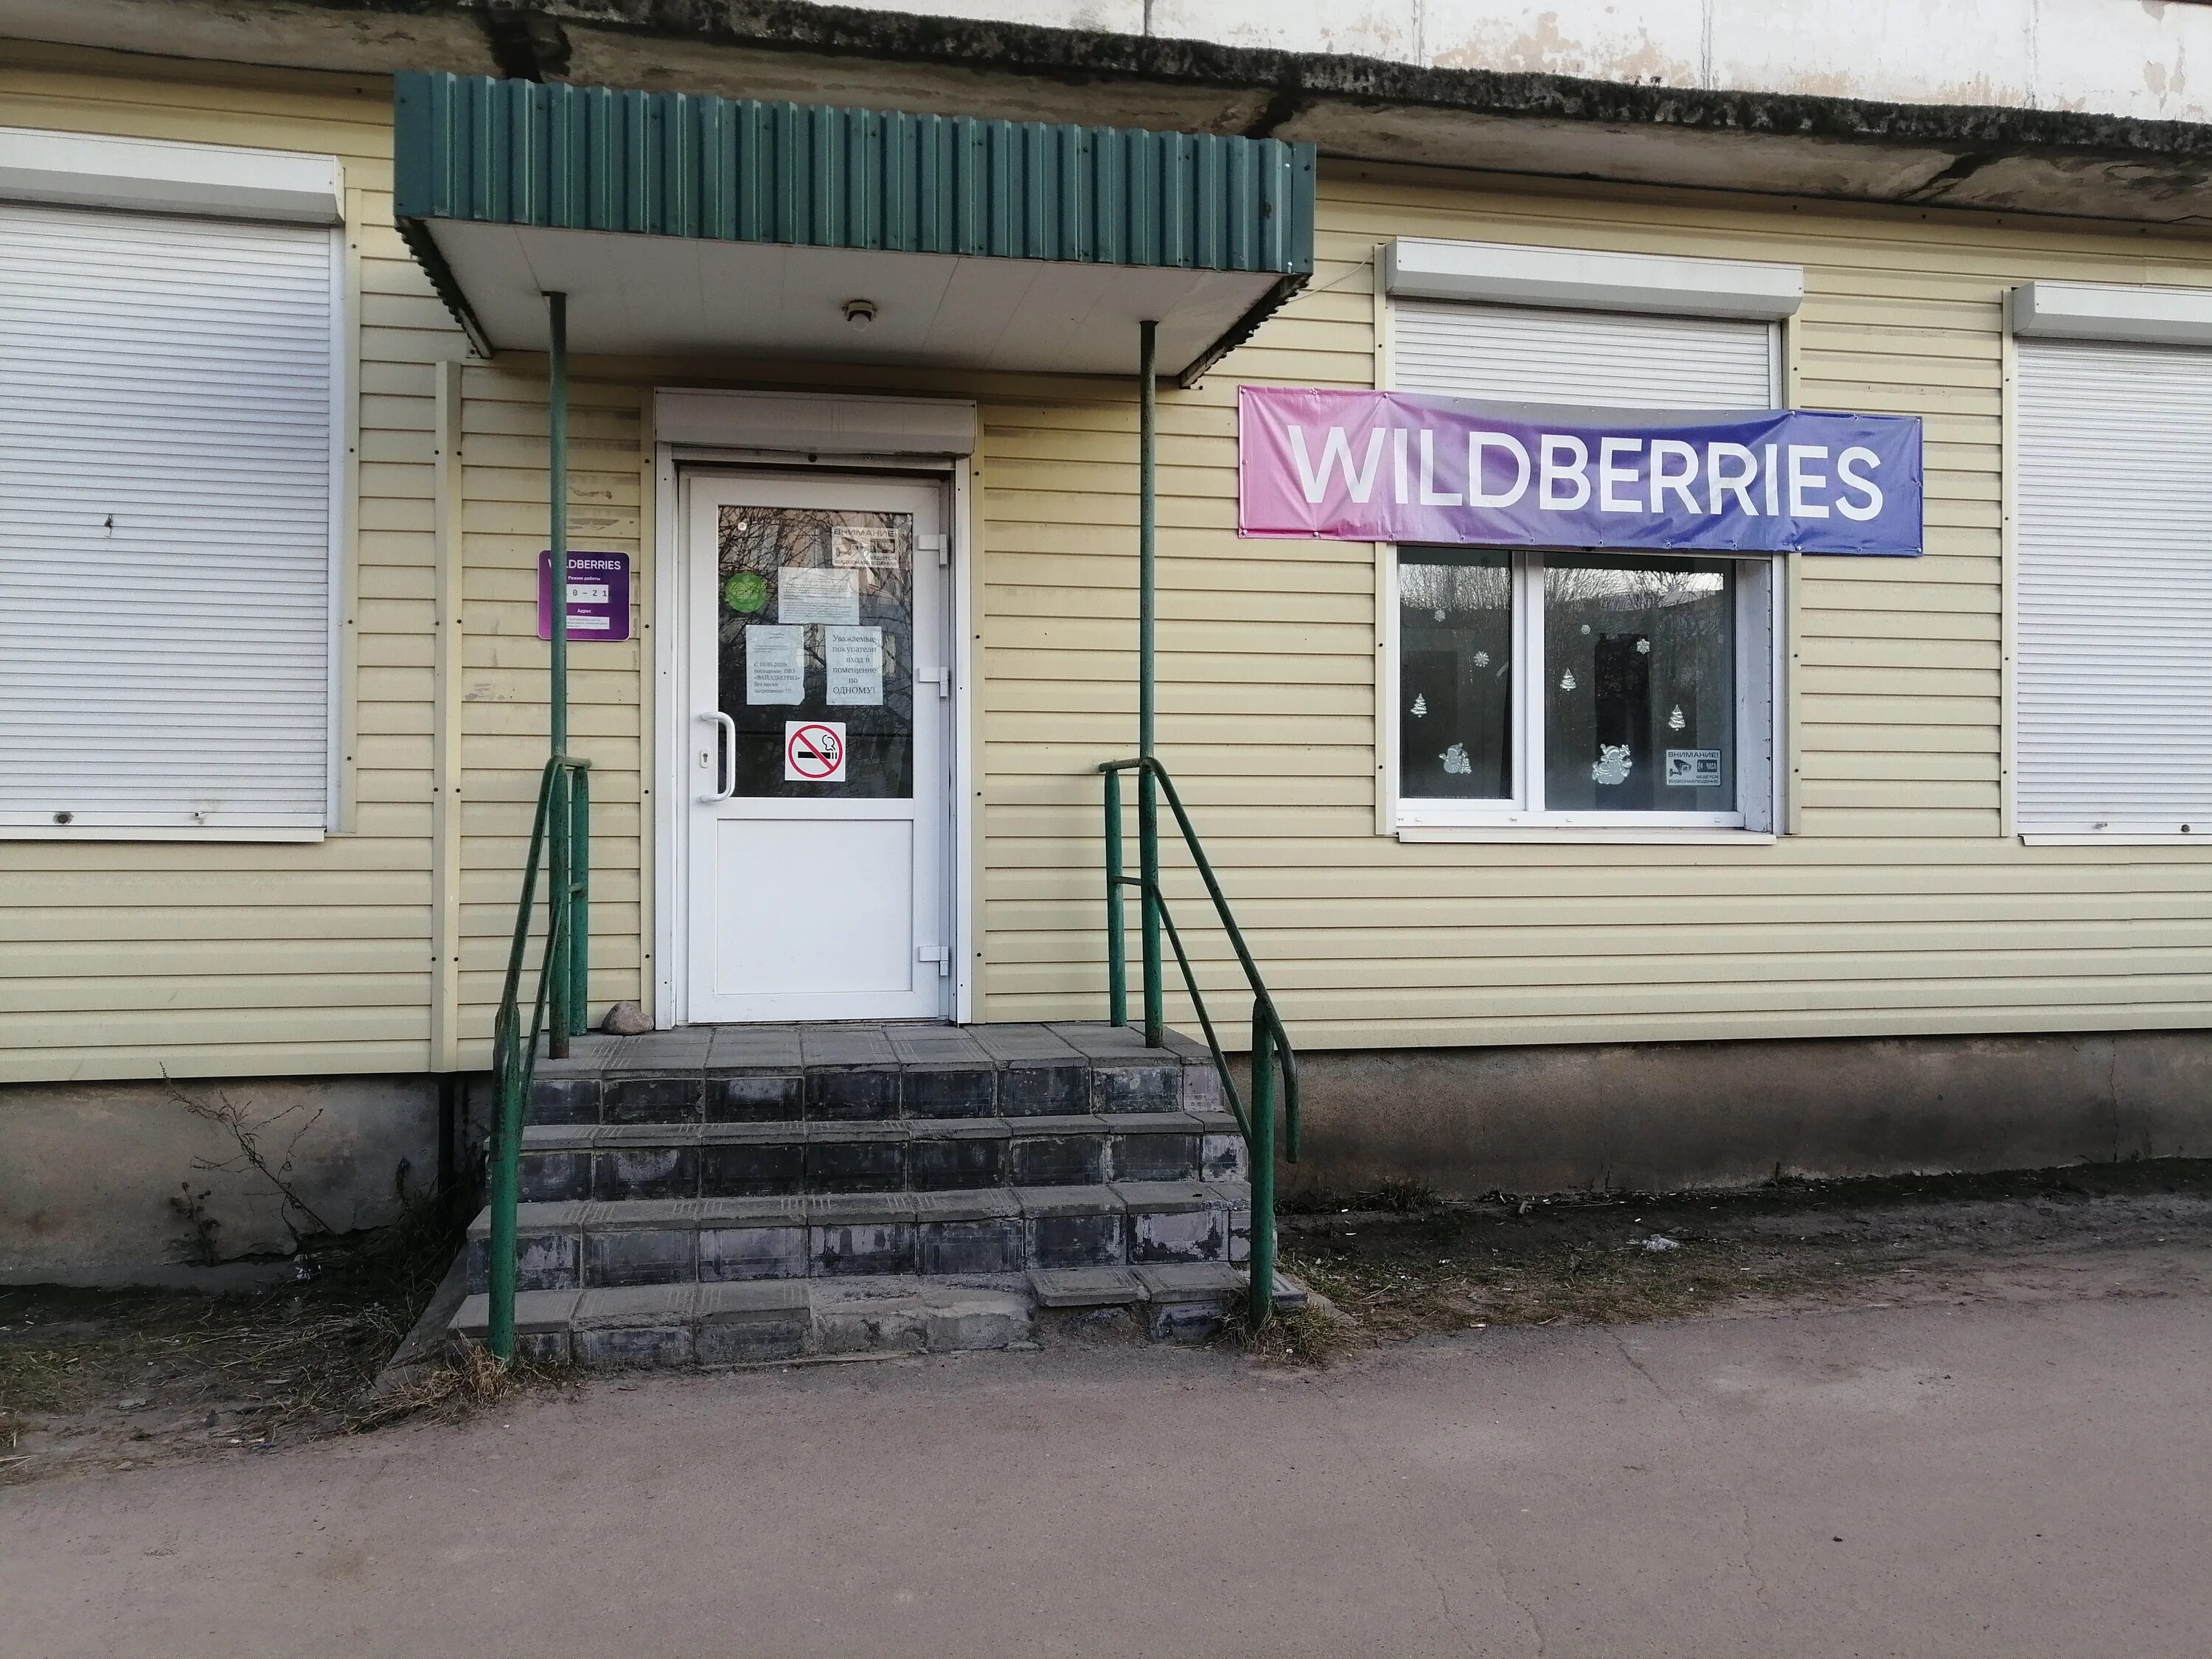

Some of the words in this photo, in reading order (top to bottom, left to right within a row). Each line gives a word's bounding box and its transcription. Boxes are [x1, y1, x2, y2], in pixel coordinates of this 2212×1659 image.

[1287, 422, 1884, 522] WILDBERRIES
[548, 559, 621, 570] DBERRIES
[832, 686, 875, 695] ОДНОМУ!
